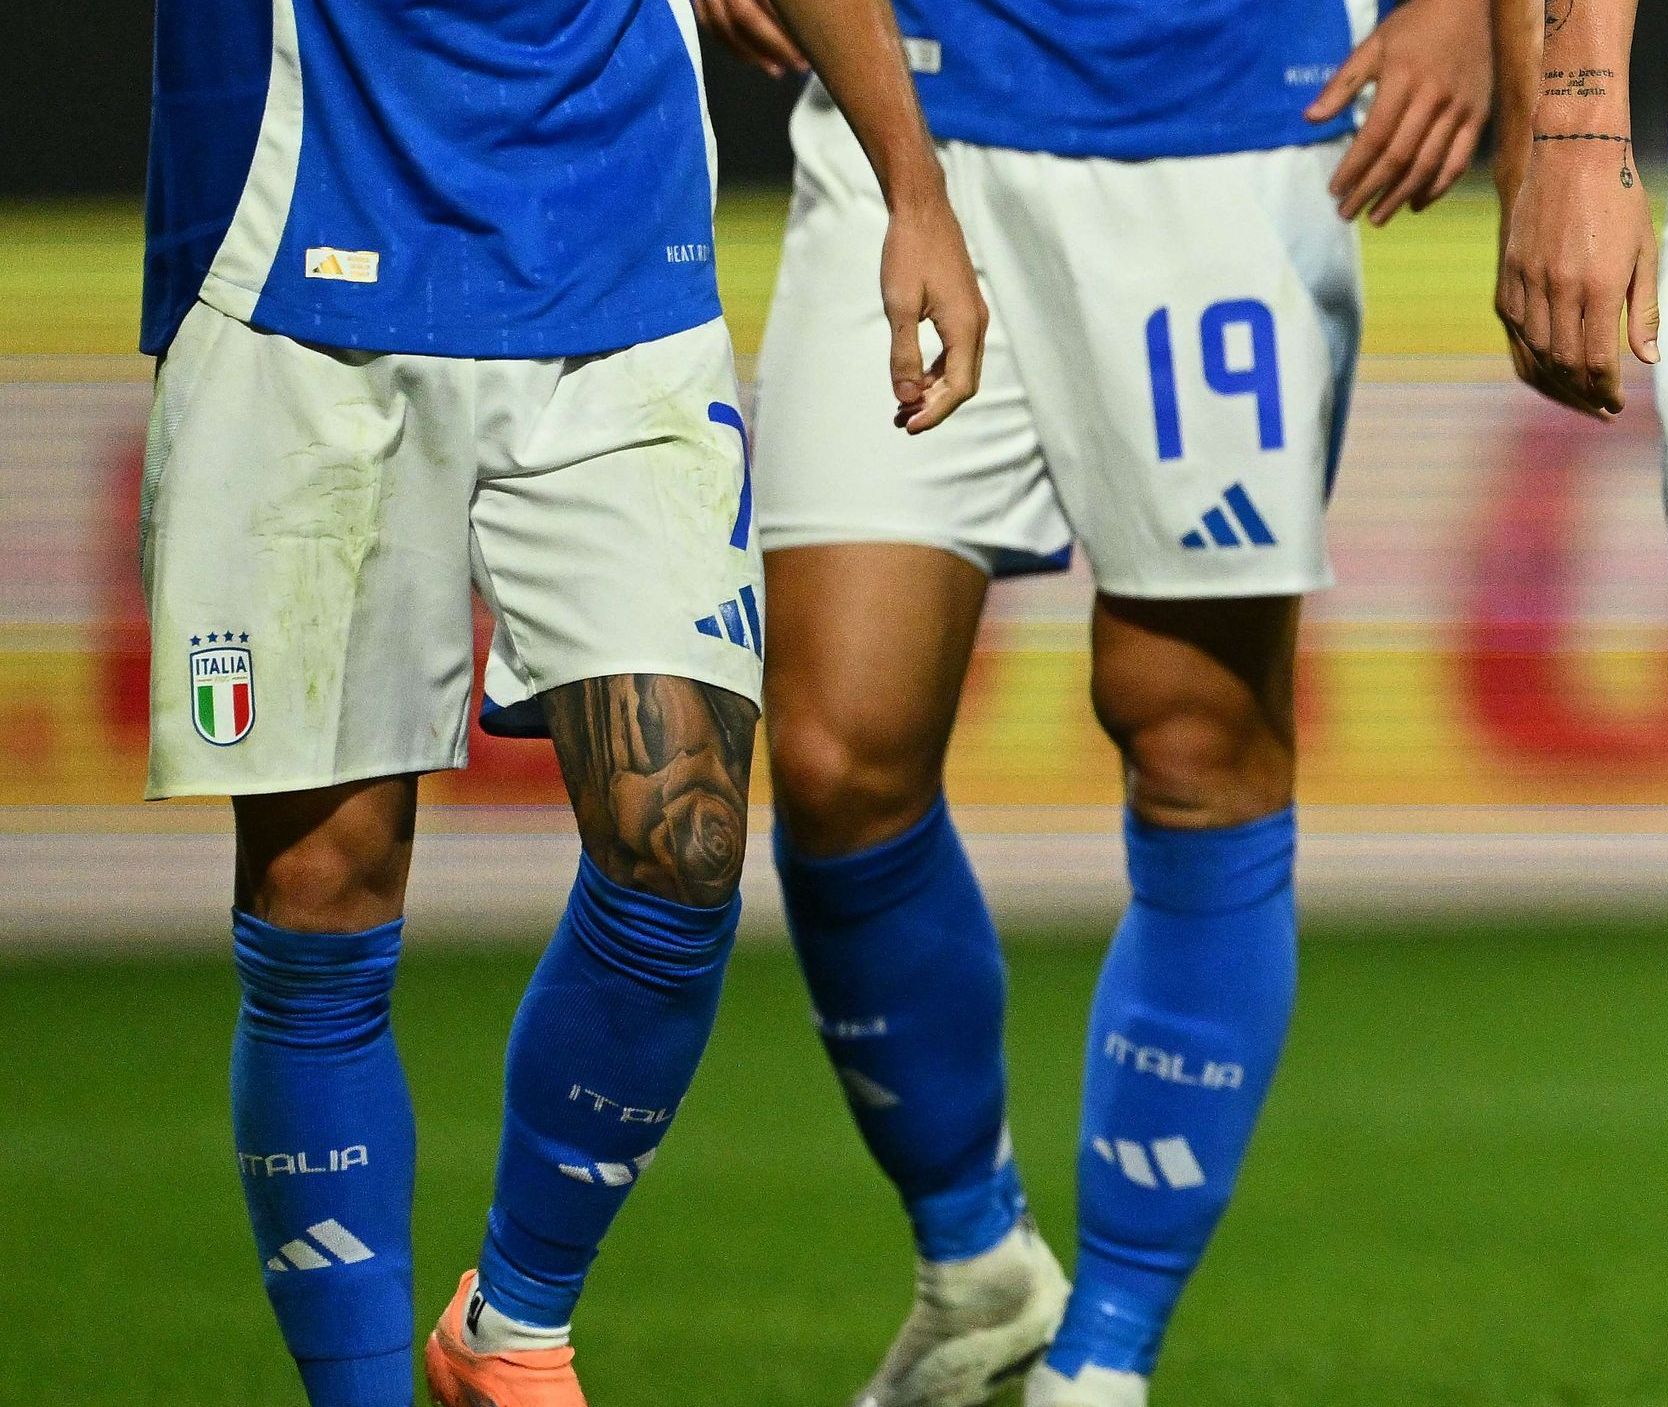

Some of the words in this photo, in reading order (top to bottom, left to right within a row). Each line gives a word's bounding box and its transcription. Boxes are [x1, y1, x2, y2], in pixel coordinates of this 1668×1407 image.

[1544, 88, 1572, 96] start
[1577, 87, 1606, 97] again
[1144, 297, 1286, 462] 19
[708, 400, 751, 551] 7
[196, 655, 248, 675] ITALIA
[1104, 1032, 1244, 1089] ITALIA
